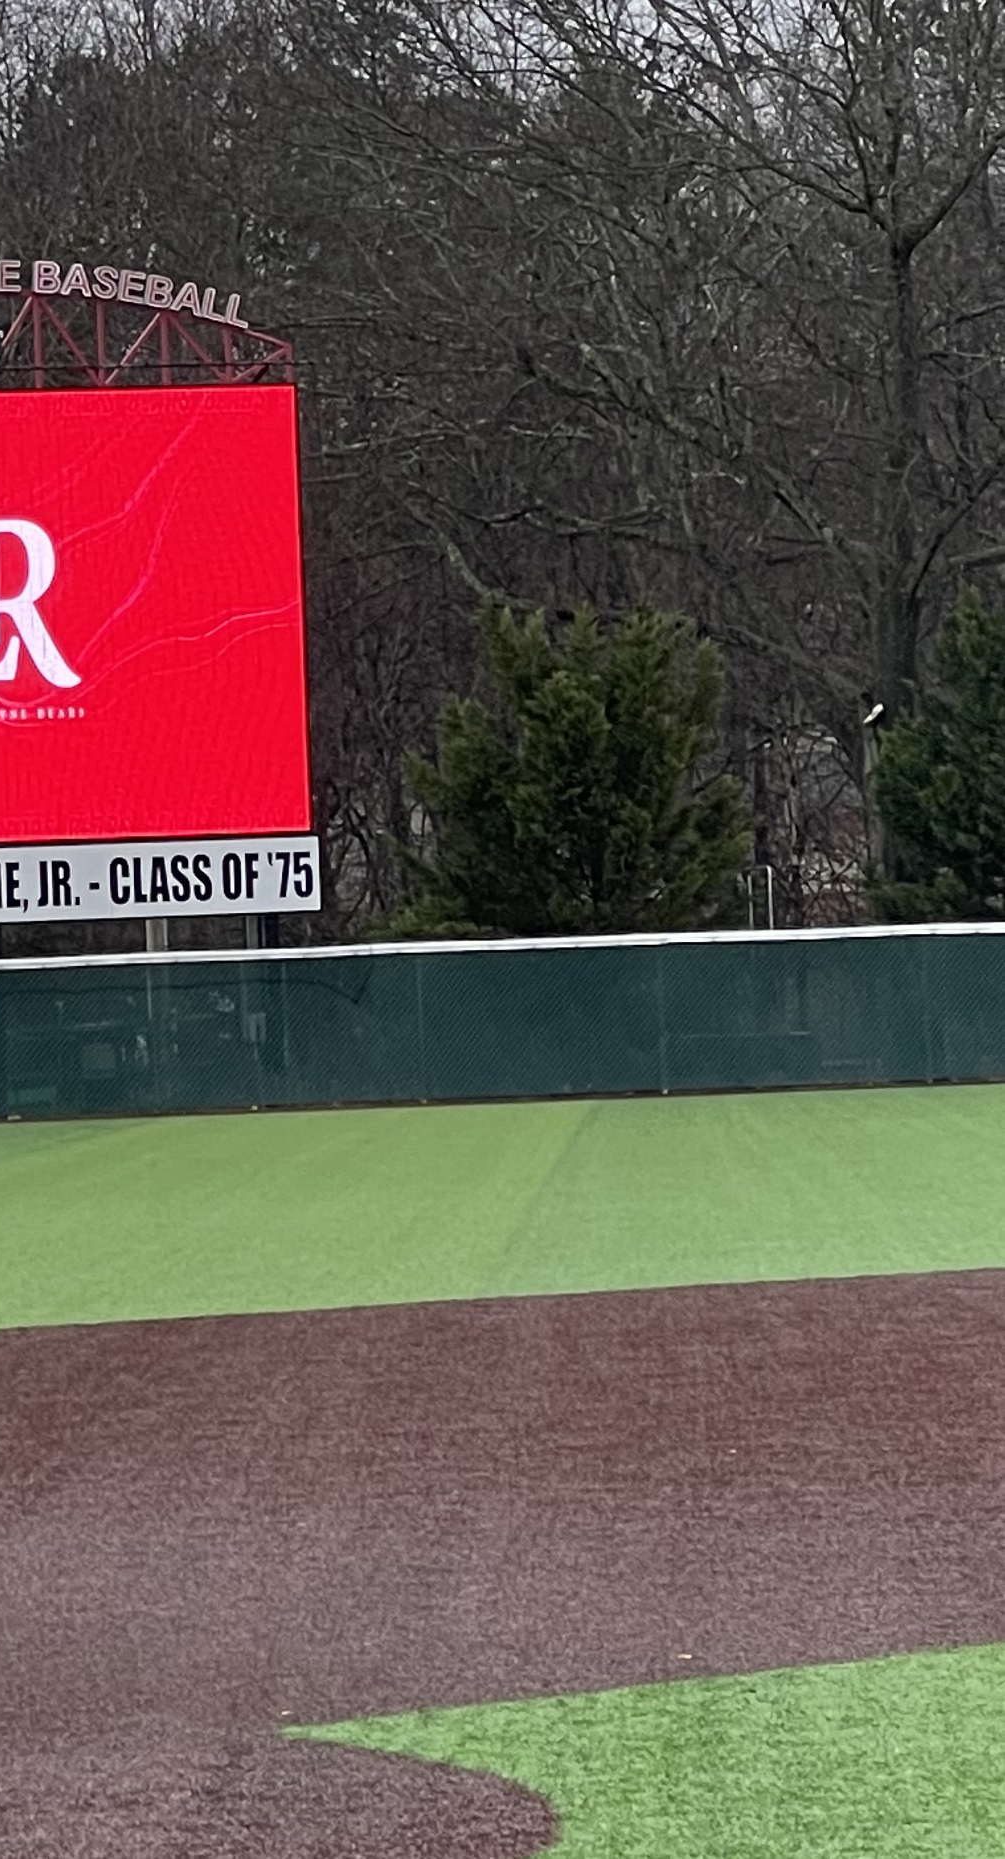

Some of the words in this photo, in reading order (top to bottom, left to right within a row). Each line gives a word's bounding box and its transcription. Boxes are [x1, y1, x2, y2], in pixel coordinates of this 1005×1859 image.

[32, 260, 248, 329] BASEBALL
[37, 860, 81, 907] JR.
[109, 854, 213, 905] CLASS
[222, 852, 259, 901] OF
[267, 851, 314, 898] '75
